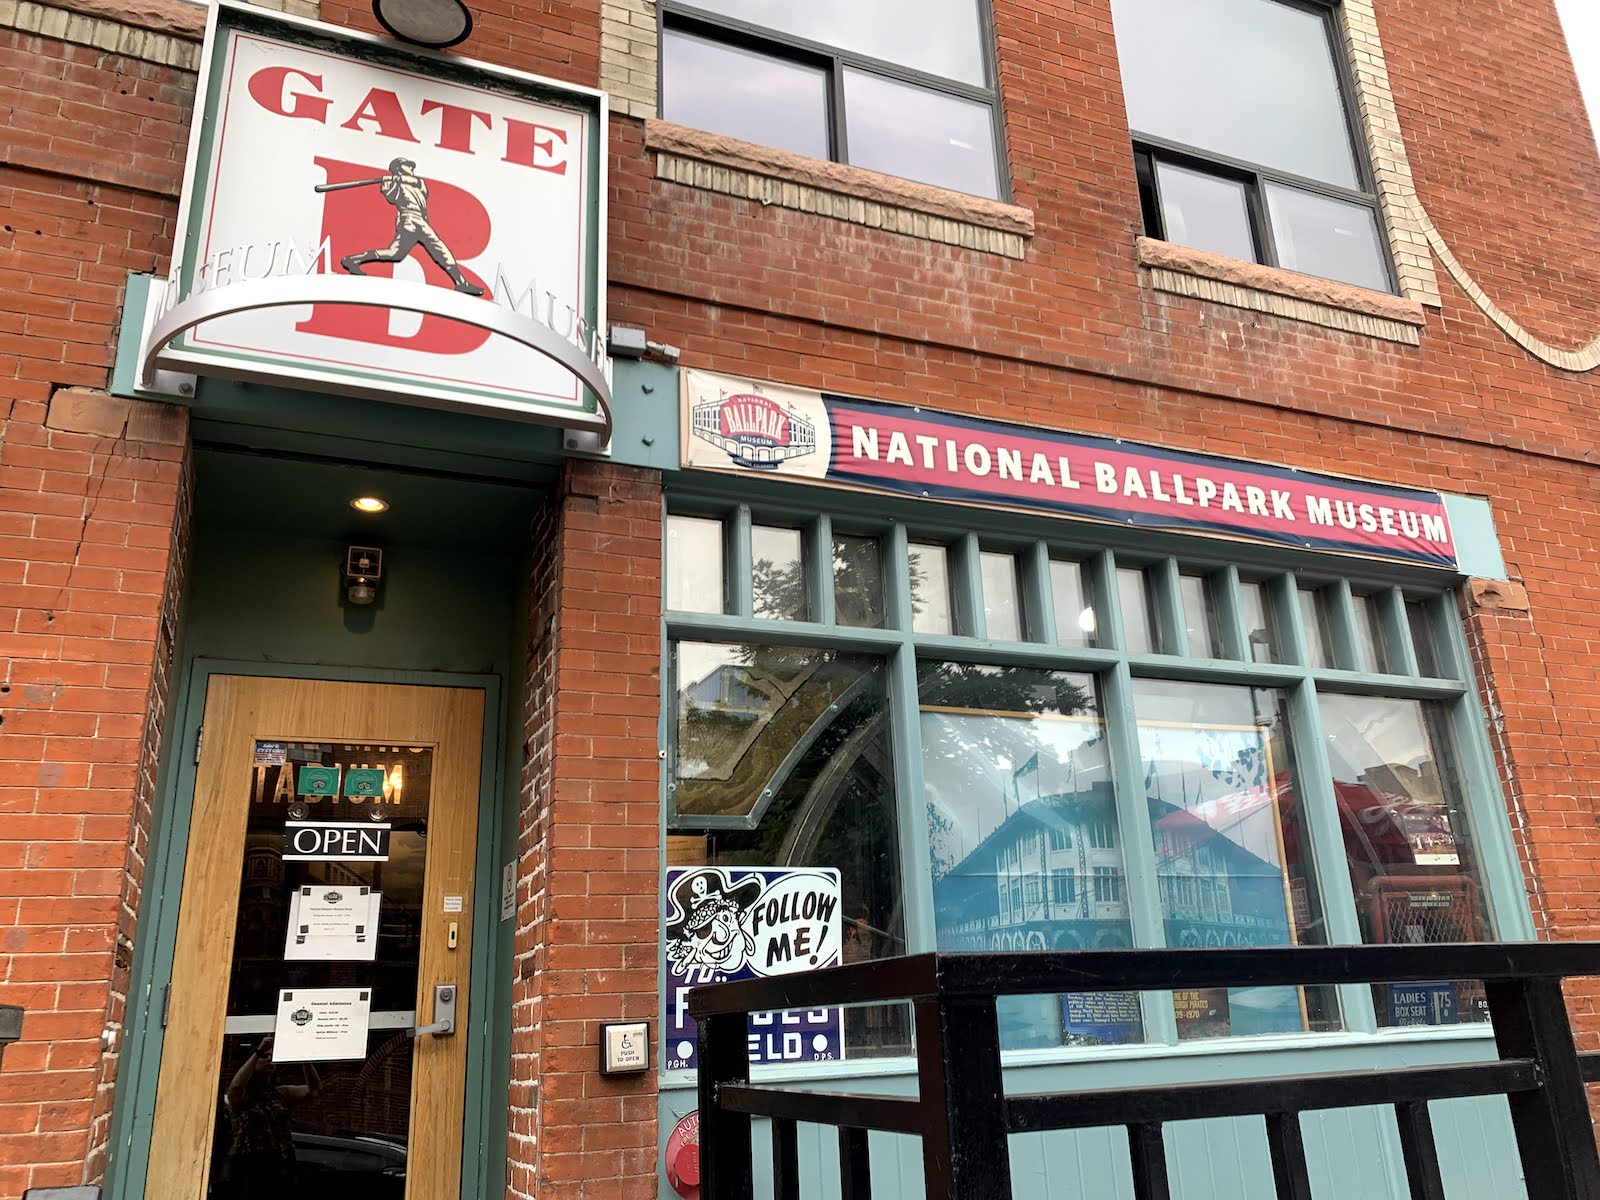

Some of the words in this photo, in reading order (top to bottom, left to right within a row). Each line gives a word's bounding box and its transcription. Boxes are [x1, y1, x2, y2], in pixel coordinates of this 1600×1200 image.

[248, 65, 569, 176] GATE
[295, 155, 492, 355] B
[738, 397, 772, 408] NATIONAL
[723, 404, 787, 440] BALLPARK
[741, 435, 773, 445] MUSEUM
[851, 425, 1081, 490] NATIONAL
[1094, 462, 1296, 522] BALLPARK
[1305, 494, 1449, 544] MUSEUM
[293, 828, 382, 855] OPEN
[752, 891, 838, 938] FOLLOW
[766, 924, 828, 968] ME!
[1394, 992, 1426, 1004] LADIES
[1395, 1006, 1410, 1018] BOX
[1410, 1005, 1427, 1017] SEAT
[749, 1032, 803, 1061] ELD
